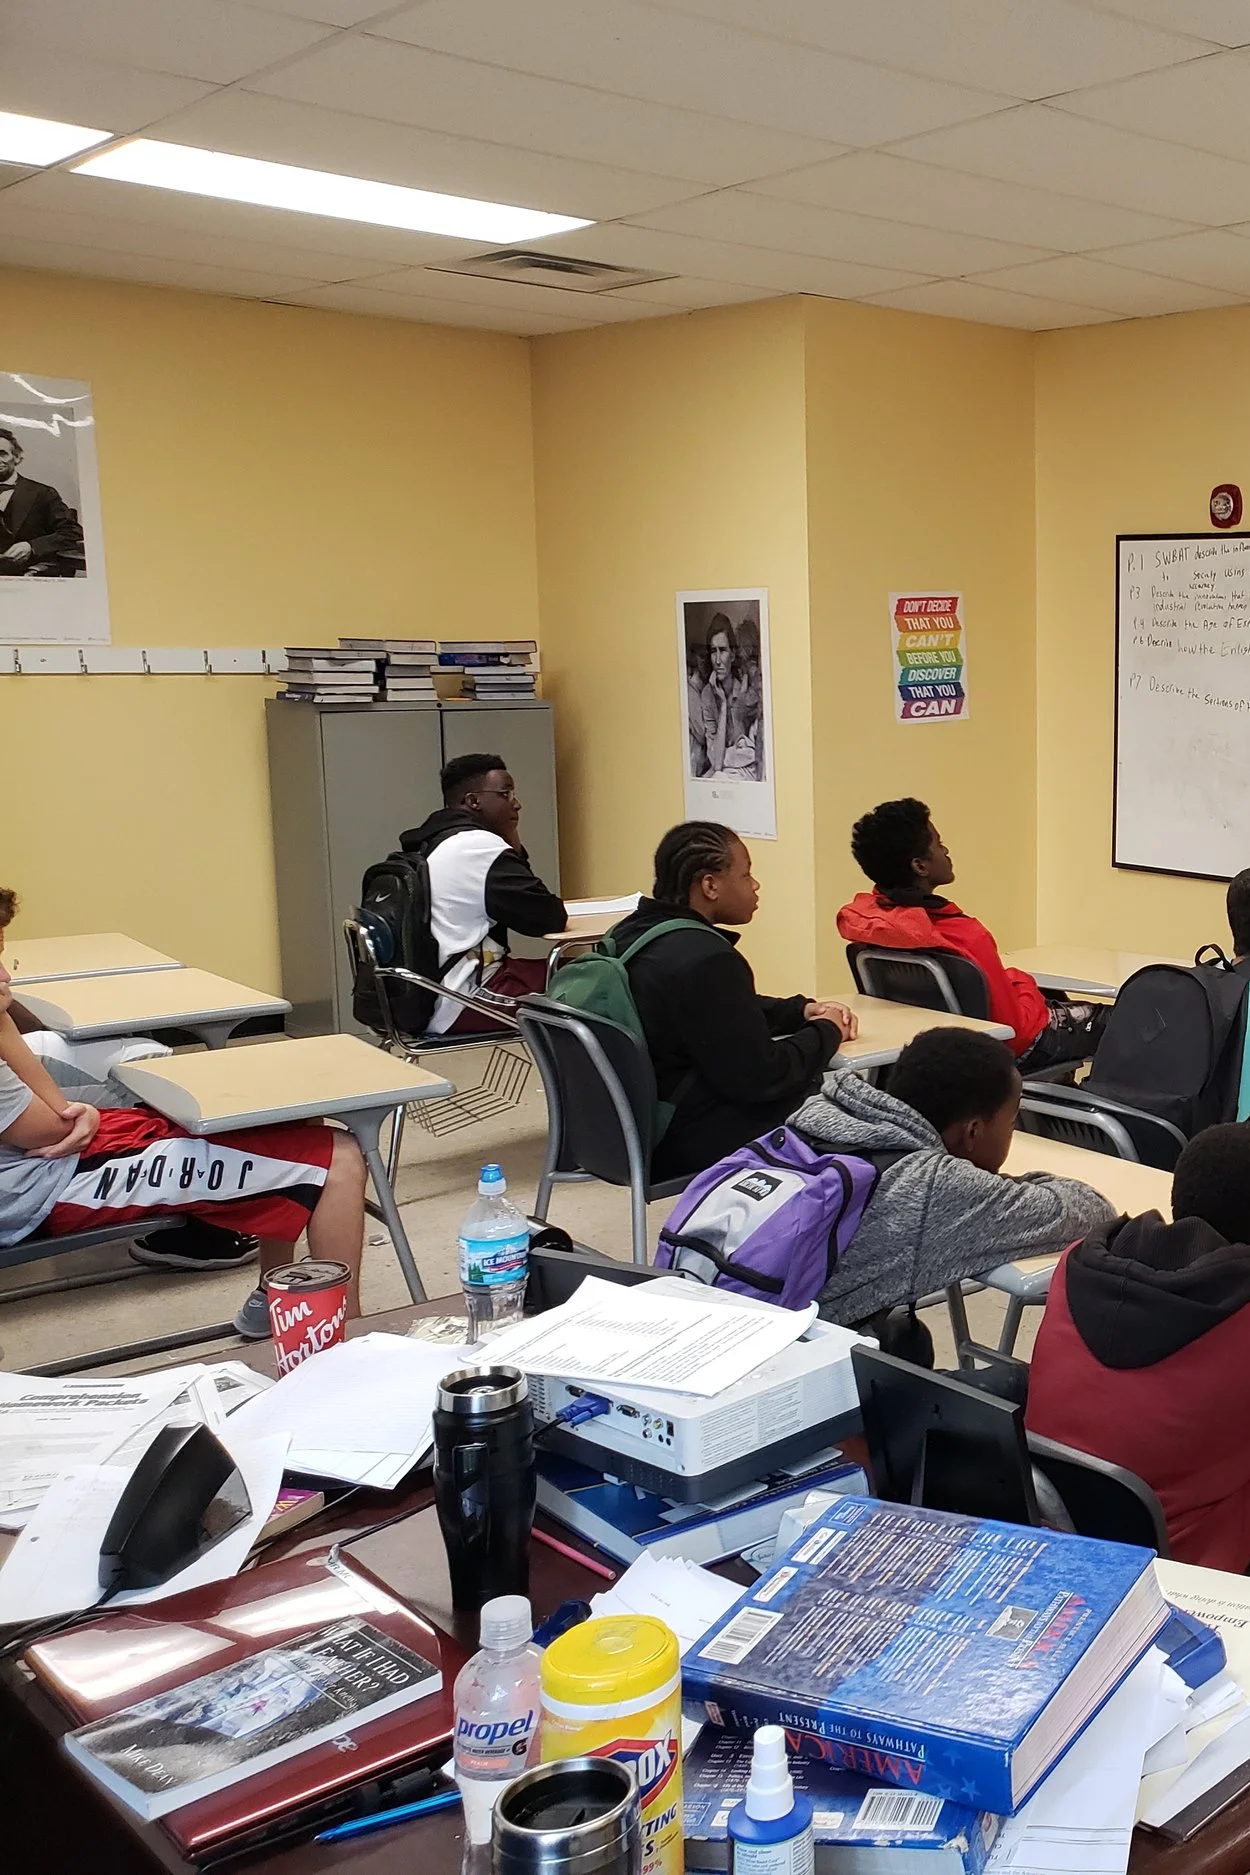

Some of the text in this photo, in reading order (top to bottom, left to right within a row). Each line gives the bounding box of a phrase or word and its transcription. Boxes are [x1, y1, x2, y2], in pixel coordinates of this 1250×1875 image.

[1155, 546, 1190, 568] SWBAT
[903, 599, 952, 613] DON'T DECIDE
[904, 616, 954, 630] THAT YOU
[1203, 619, 1218, 631] Age
[1223, 617, 1233, 629] of
[905, 633, 954, 648] CAN'T
[1177, 640, 1198, 655] how
[906, 650, 956, 665] BEFORE YOU
[908, 667, 957, 682] DISCOVER
[909, 684, 956, 699] THAT YOU
[910, 700, 956, 717] CAN
[1234, 700, 1244, 711] of
[93, 1155, 253, 1200] JORDAN
[483, 1257, 496, 1267] ICE
[269, 1297, 313, 1337] Tim
[19, 1392, 142, 1402] Comprehension
[85, 1398, 150, 1407] Packets
[1190, 1594, 1217, 1605] doing
[320, 1625, 359, 1656] WHAT
[355, 1648, 376, 1666] IF
[378, 1660, 409, 1685] HAD
[313, 1647, 380, 1693] FATHER?
[457, 1709, 534, 1746] propel
[779, 1712, 826, 1735] PRESENT
[829, 1724, 847, 1735] THE
[851, 1728, 861, 1738] TO
[866, 1732, 925, 1759] PATHWAYS
[785, 1728, 924, 1785] AMERICA
[122, 1744, 178, 1787] MIKE DEAN
[683, 1803, 706, 1811] ARSON
